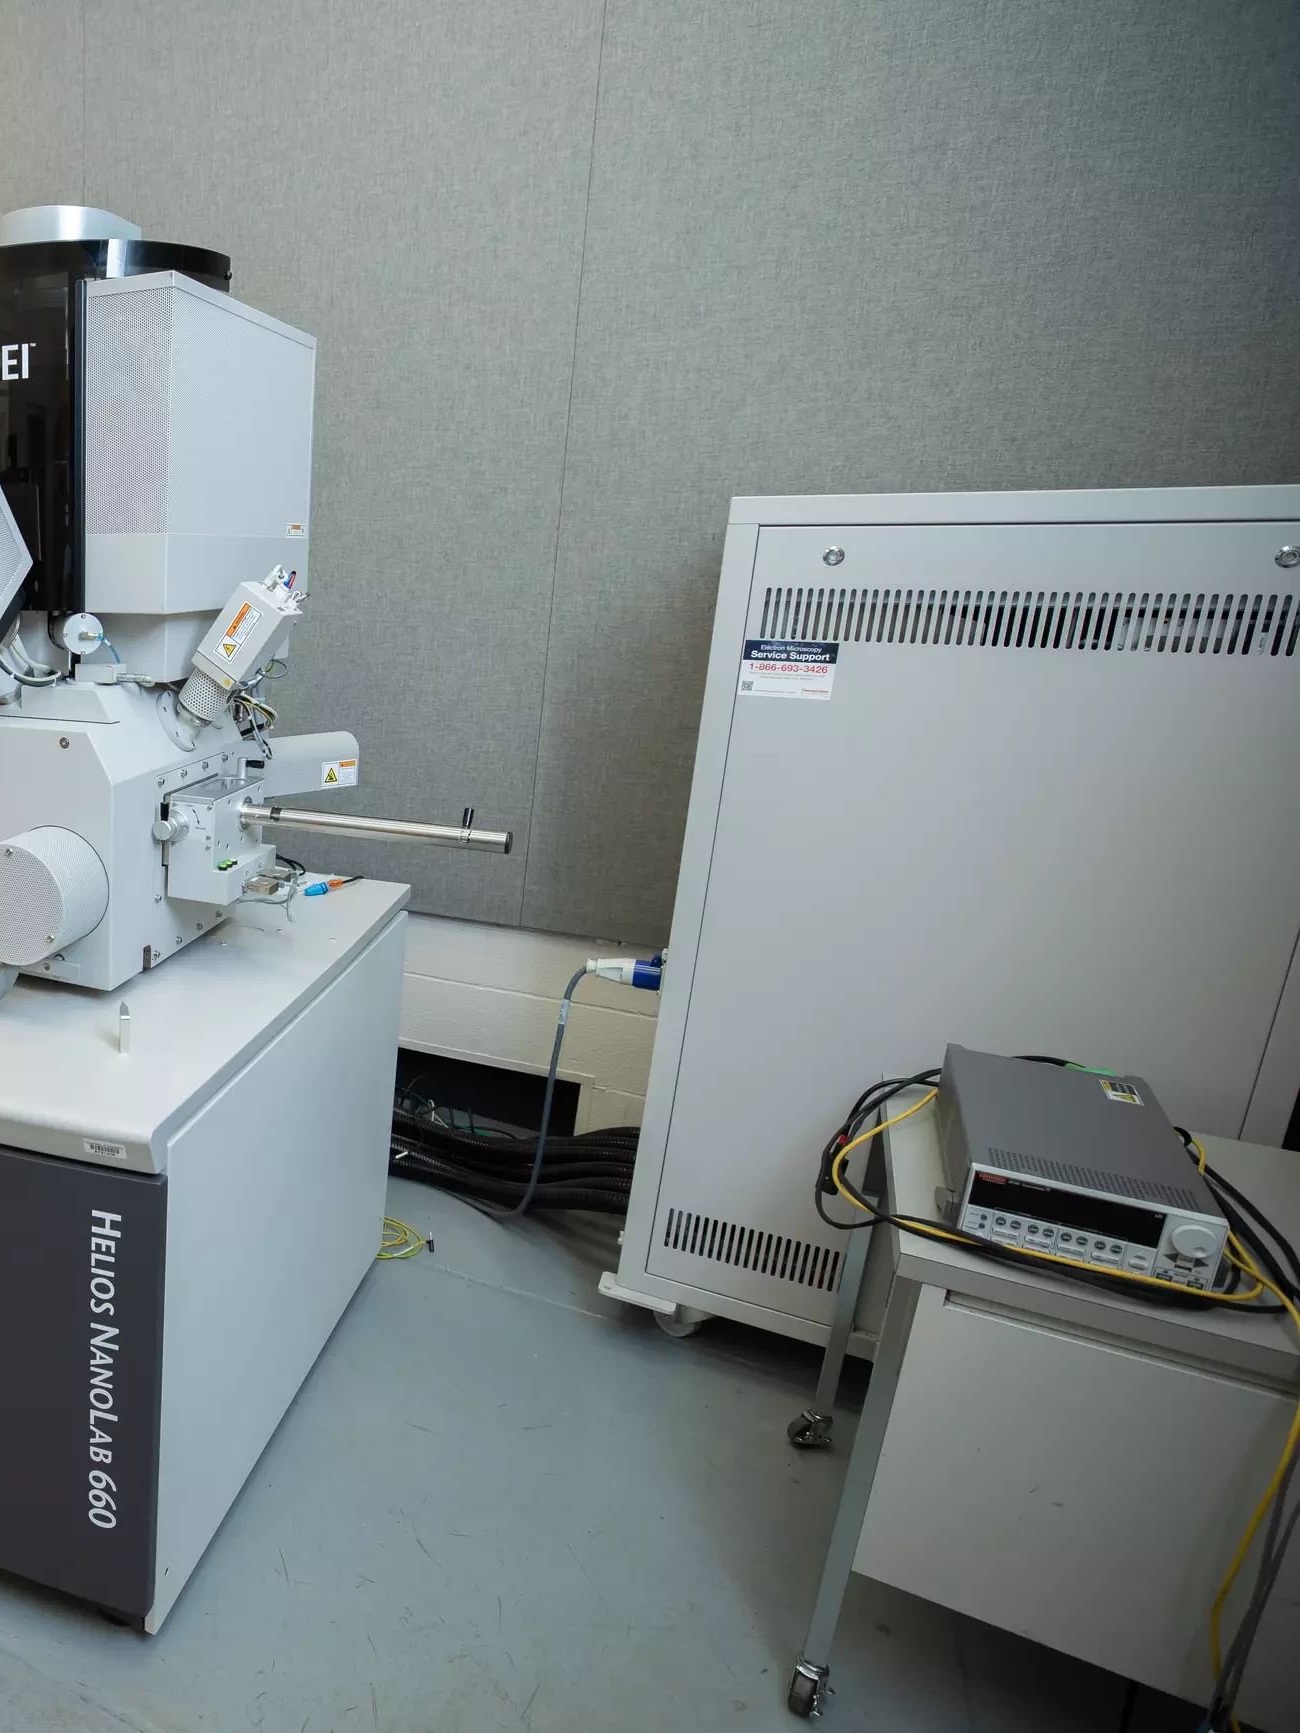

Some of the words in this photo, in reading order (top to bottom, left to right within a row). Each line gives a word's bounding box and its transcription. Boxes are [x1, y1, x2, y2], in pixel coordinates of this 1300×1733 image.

[786, 645, 823, 653] Microscopy
[750, 650, 788, 660] Service
[789, 652, 831, 662] Support
[749, 662, 829, 674] 1-866-693-3426
[87, 1469, 117, 1529] 660
